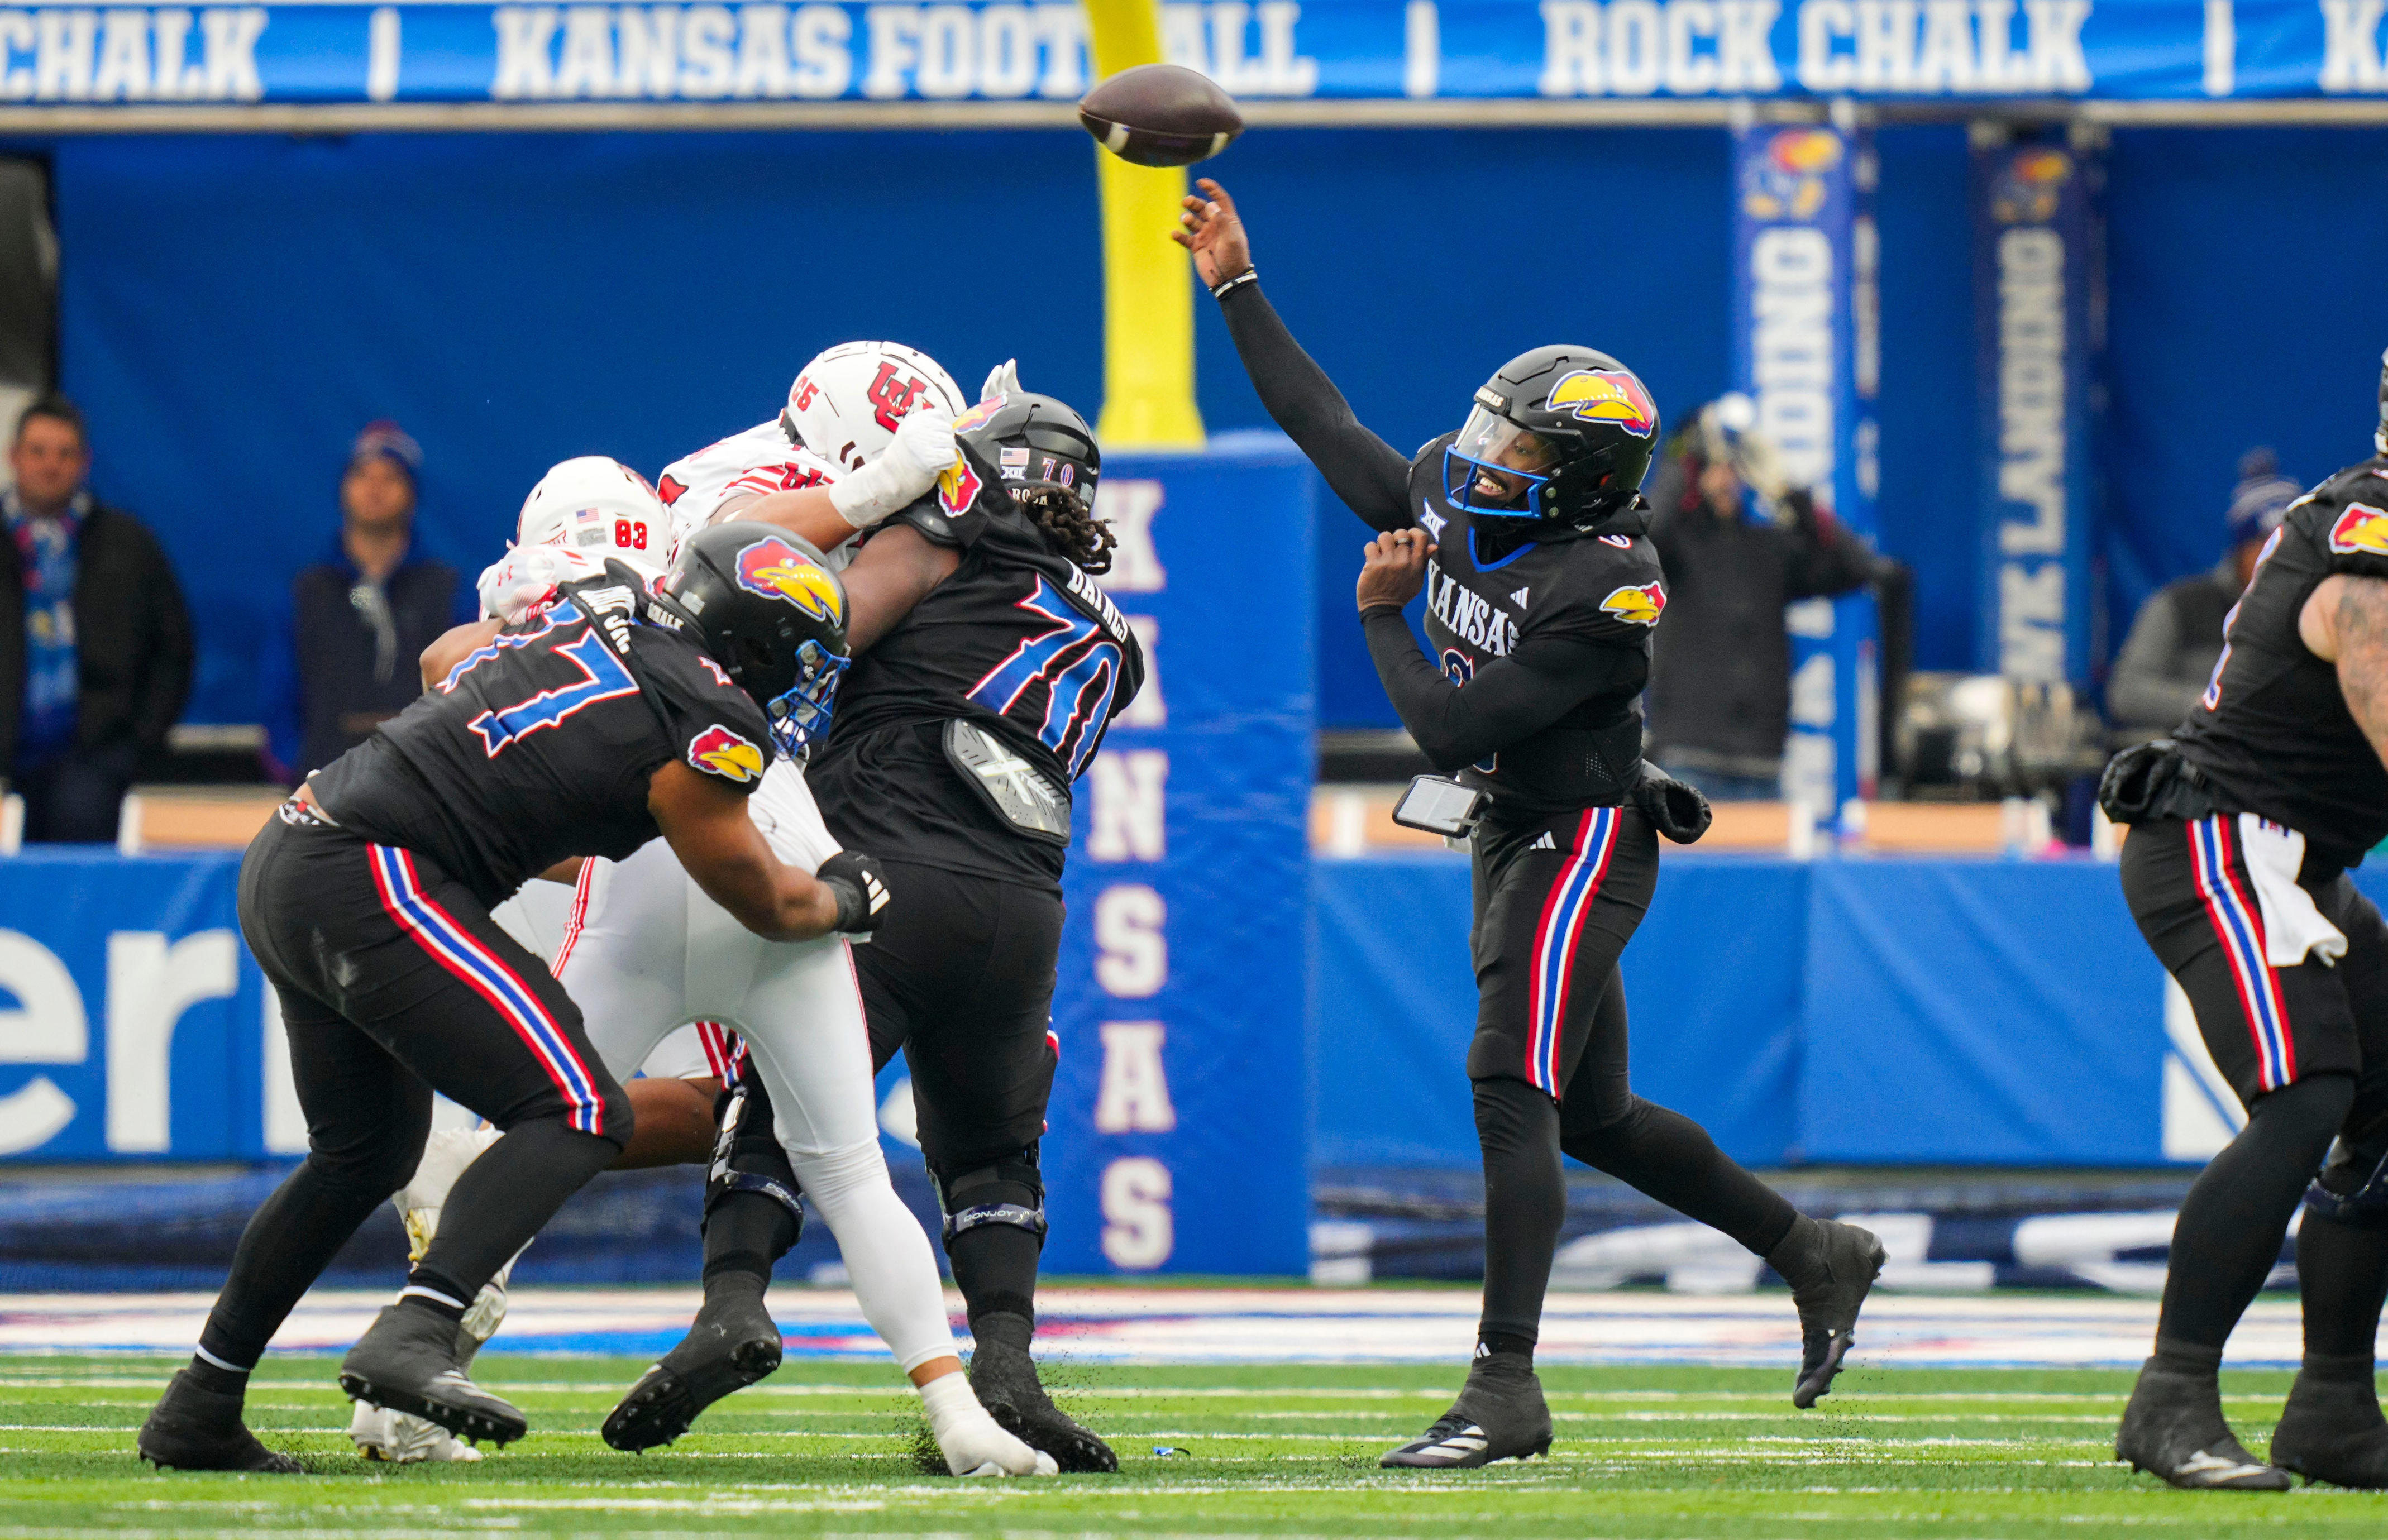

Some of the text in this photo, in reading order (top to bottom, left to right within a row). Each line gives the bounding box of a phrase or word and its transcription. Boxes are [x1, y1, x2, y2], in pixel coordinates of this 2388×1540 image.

[0, 9, 268, 101] CHALK
[490, 2, 1319, 99] KANSAS FOOTALL
[1537, 0, 2095, 96] ROCK CHALK
[2318, 0, 2388, 92] K
[1042, 457, 1074, 489] 70
[615, 519, 648, 551] 83
[1427, 558, 1520, 657] KANSAS
[434, 595, 641, 759] 77
[964, 572, 1125, 786] 70
[1092, 480, 1174, 1269] KANSAS
[964, 1209, 1016, 1222] DONJOY
